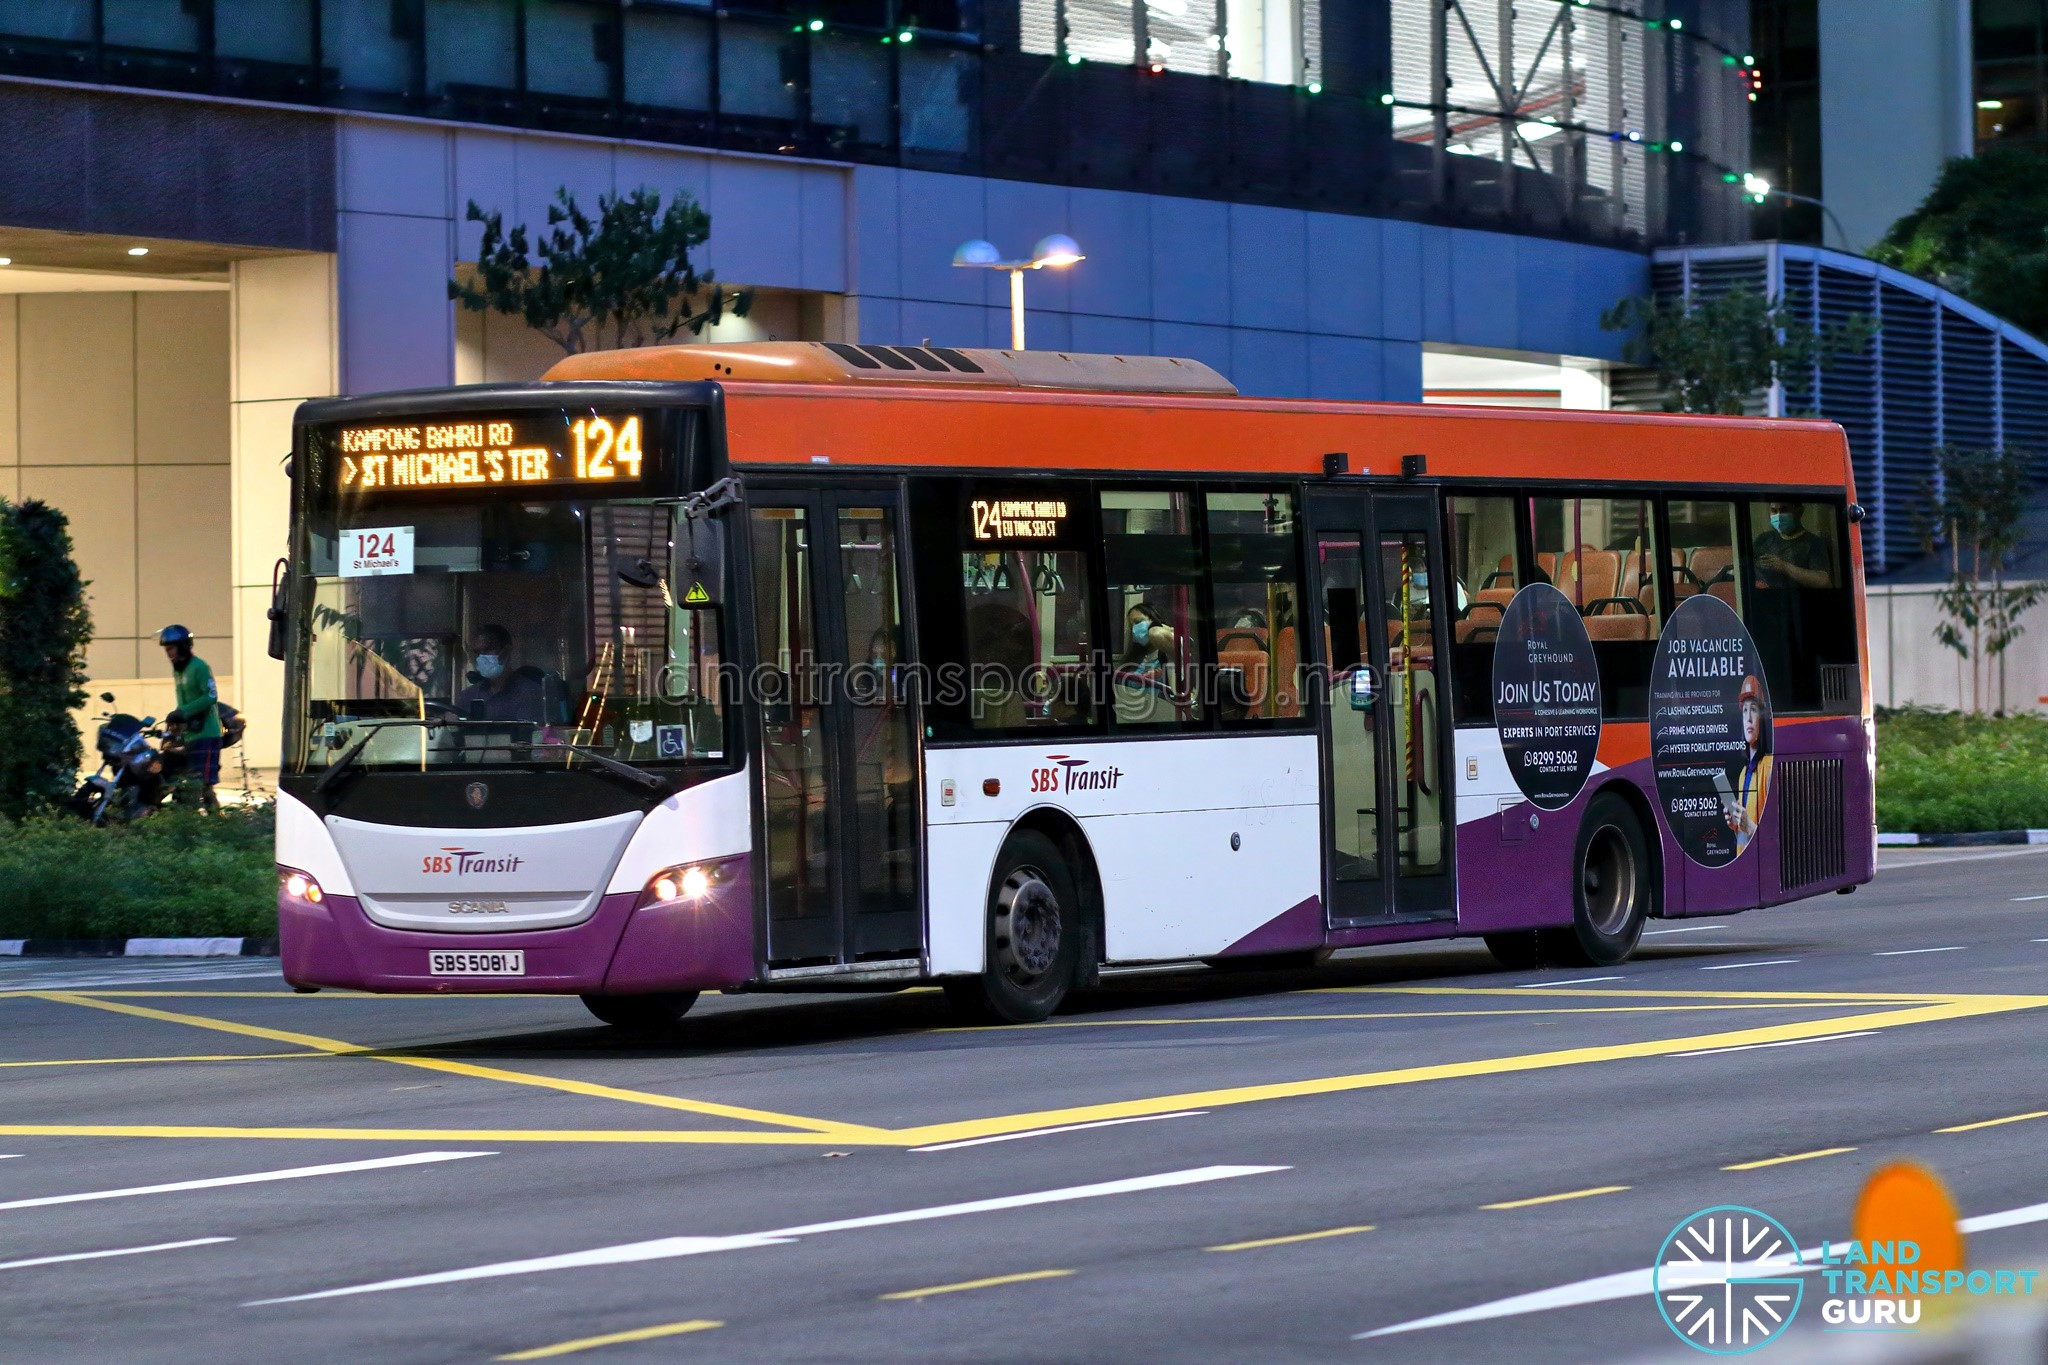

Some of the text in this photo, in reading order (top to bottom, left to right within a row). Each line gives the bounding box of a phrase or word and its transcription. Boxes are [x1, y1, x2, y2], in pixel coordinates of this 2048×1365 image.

[342, 422, 514, 452] KAMPONG BAHRU RD
[572, 416, 643, 479] 124
[392, 450, 504, 486] MICHAEL'S
[508, 448, 549, 481] TER
[971, 500, 1002, 539] 124
[358, 533, 395, 558] 124
[353, 559, 399, 569] St Michael's
[1527, 640, 1548, 650] ROYAL
[1668, 638, 1743, 654] JOB VACANCIES
[1528, 653, 1574, 663] GREYHOUND
[1668, 656, 1744, 678] AVAILABLE
[1498, 680, 1596, 703] JOIN US TODAY
[1667, 704, 1723, 715] LASHING SPECIALISTS
[1503, 725, 1597, 738] EXPERTS IN PORT SERVICES
[1669, 724, 1728, 735] PRIME MOVER DRIVERS
[1670, 741, 1746, 753] HYSTER FORKLIFT OPERATORS
[1532, 750, 1578, 765] 8299 5062
[1030, 759, 1124, 795] SBS Transit
[1679, 797, 1718, 811] 8299 5062
[422, 851, 526, 876] SBS Transit
[448, 901, 509, 914] SCANIA
